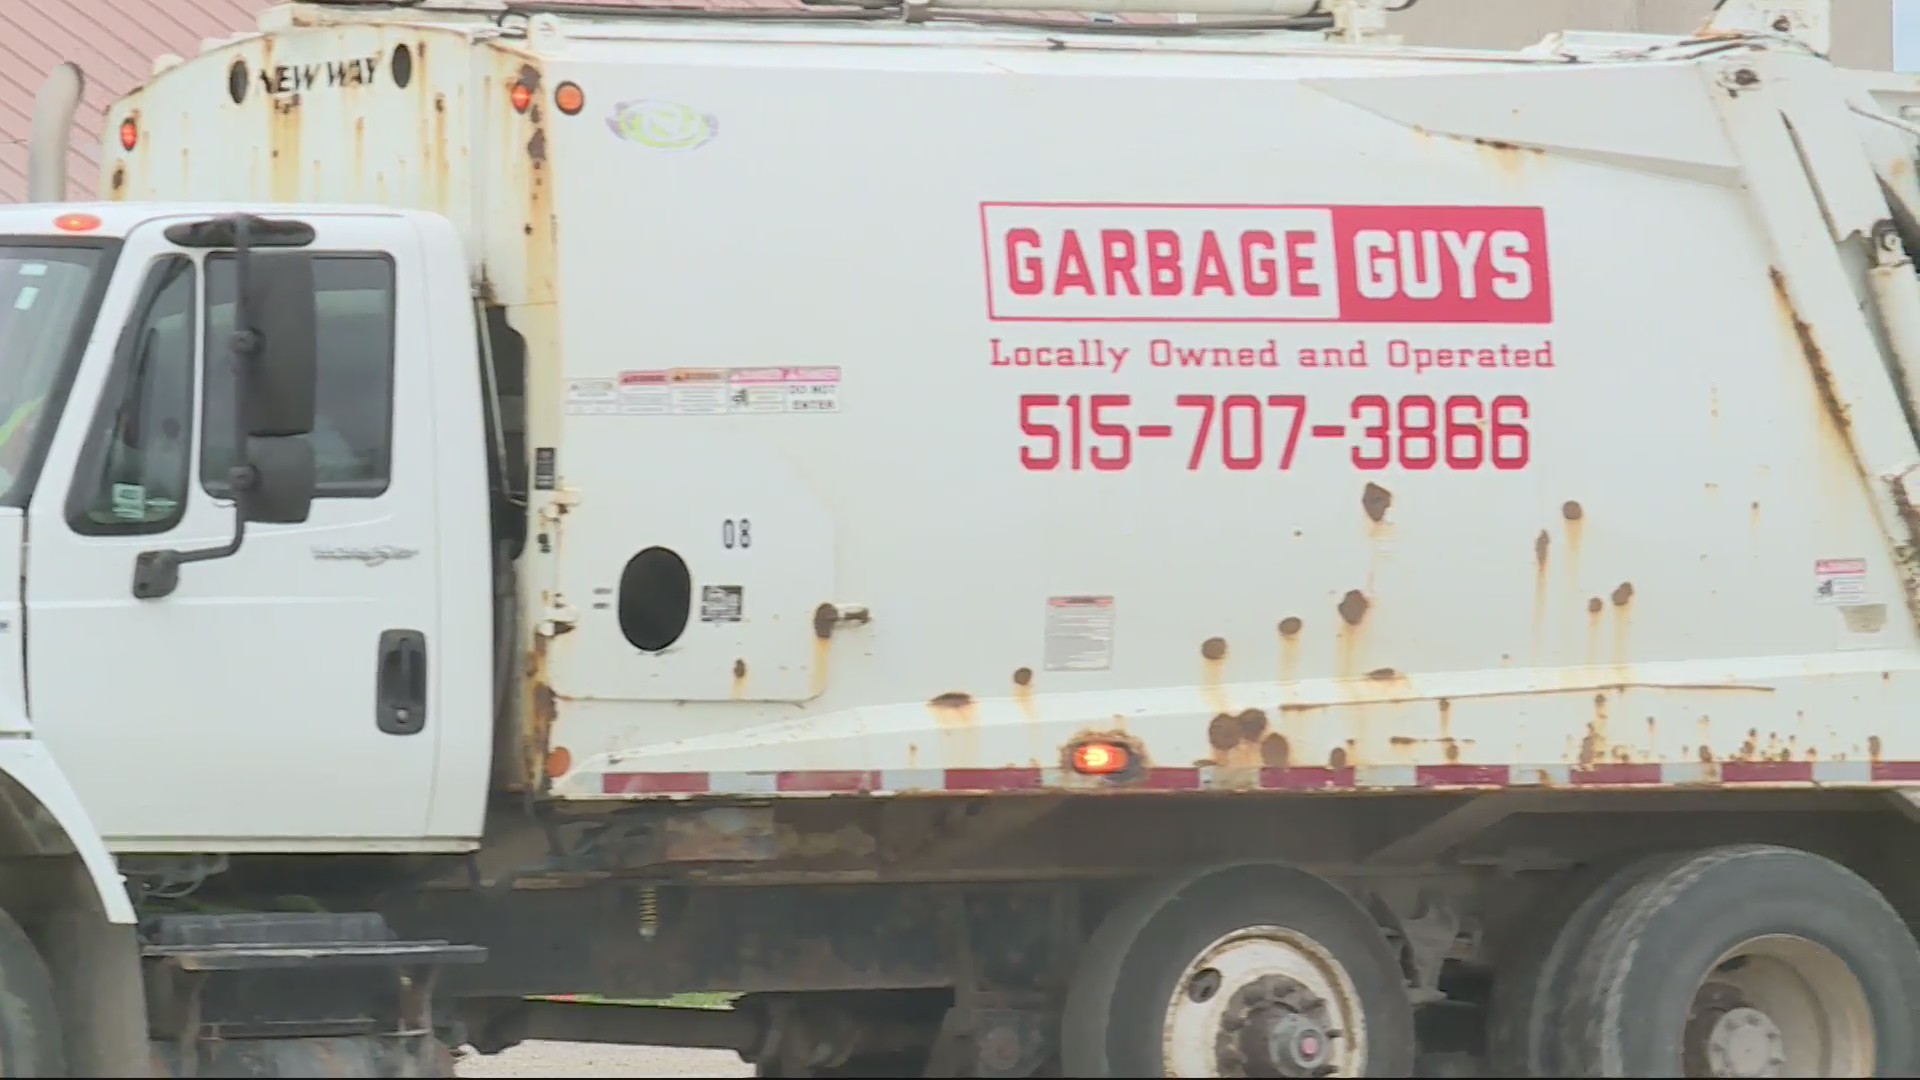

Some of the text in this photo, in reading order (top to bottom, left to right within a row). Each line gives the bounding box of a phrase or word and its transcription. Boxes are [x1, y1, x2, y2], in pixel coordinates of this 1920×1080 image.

[1006, 227, 1534, 300] GARBAGE GUYS
[990, 338, 1555, 374] Locally Owned and Operated
[792, 400, 834, 410] ENTER
[1018, 394, 1530, 471] 515-707-3866
[723, 518, 751, 549] 08
